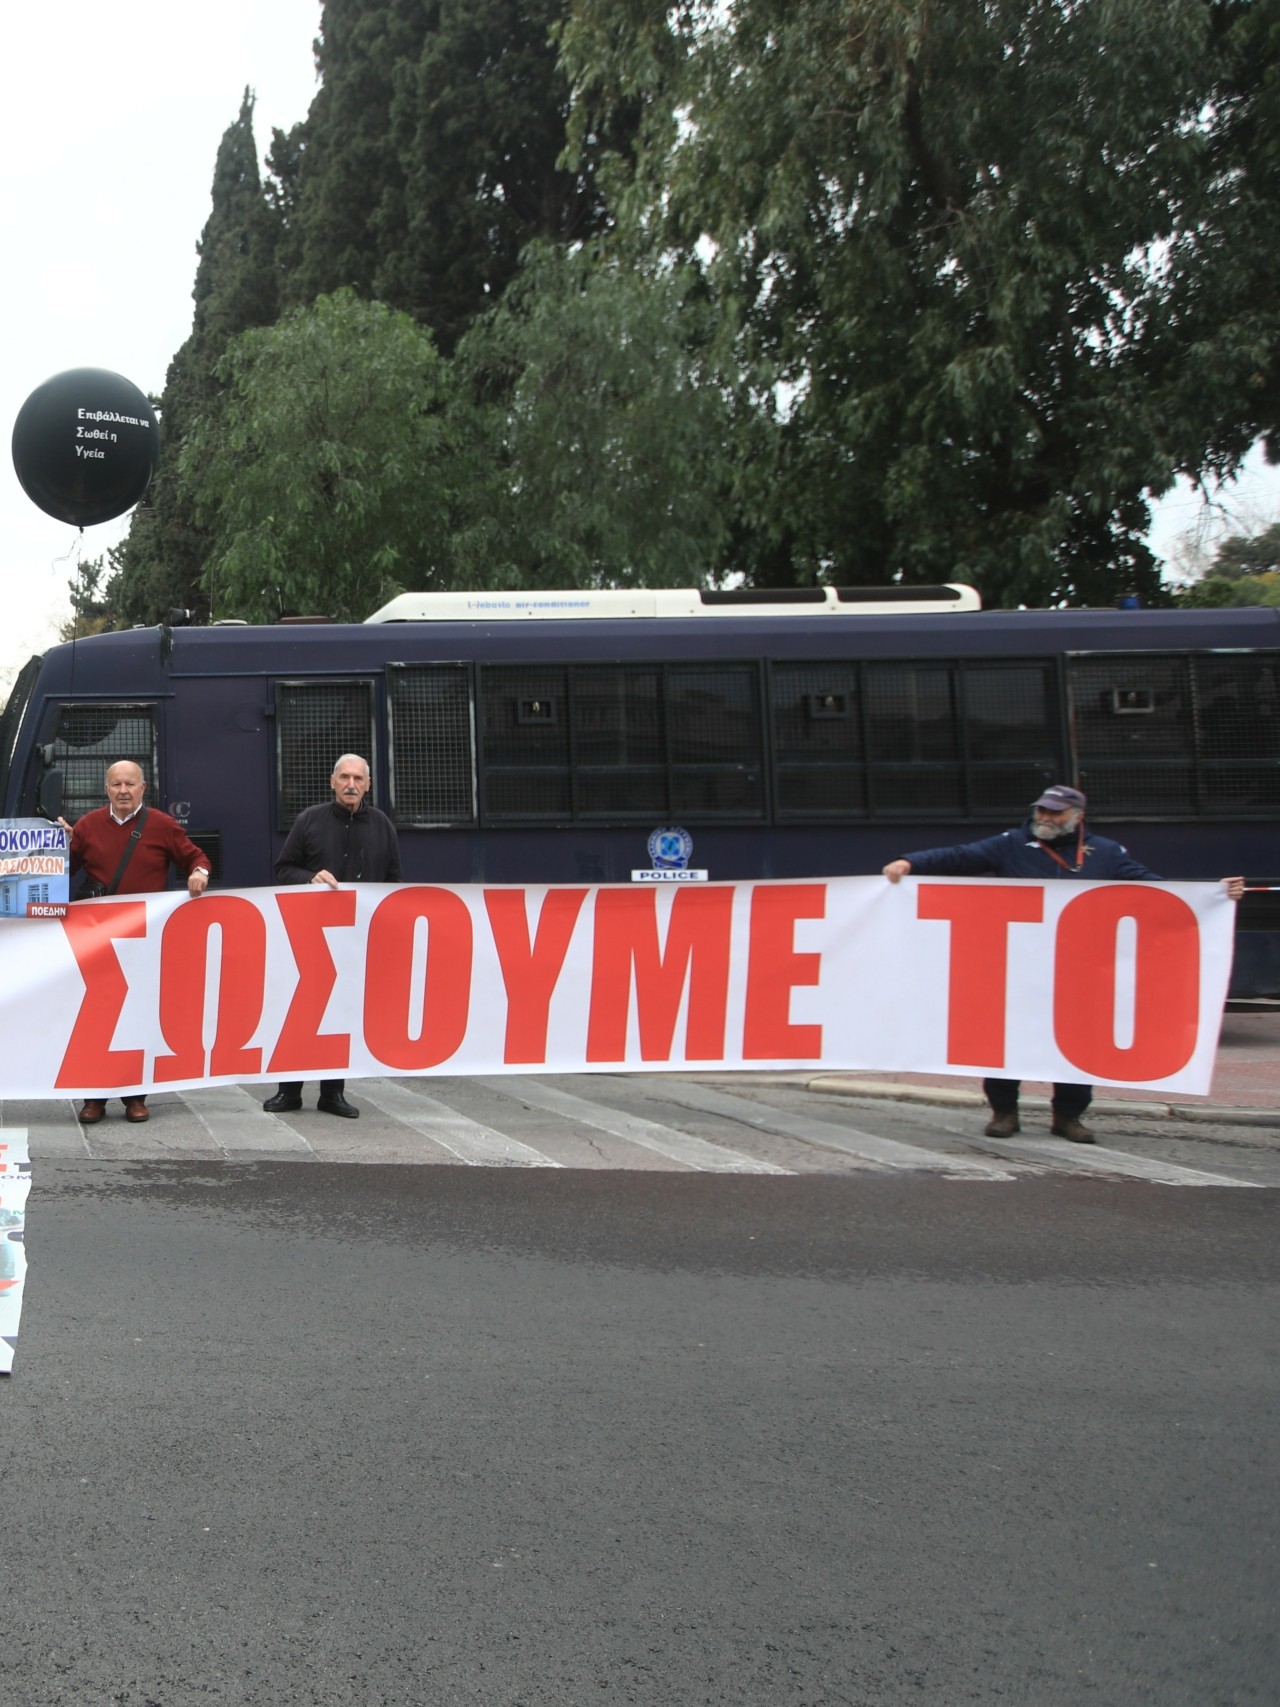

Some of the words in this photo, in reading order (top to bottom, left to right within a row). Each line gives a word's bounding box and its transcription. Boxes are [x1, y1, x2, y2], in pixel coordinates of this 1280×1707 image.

[77, 408, 140, 425] Επιβάλλεται
[140, 419, 150, 428] να
[76, 426, 109, 440] Σωθεί
[110, 433, 117, 443] η
[75, 445, 105, 459] Υγεία
[515, 600, 590, 609] air-conditioner
[31, 906, 66, 916] ΠΟΕΔΗΝ
[54, 884, 827, 1089] ΣΩΣΟΥΜΕ
[917, 884, 1201, 1082] ΤΟ
